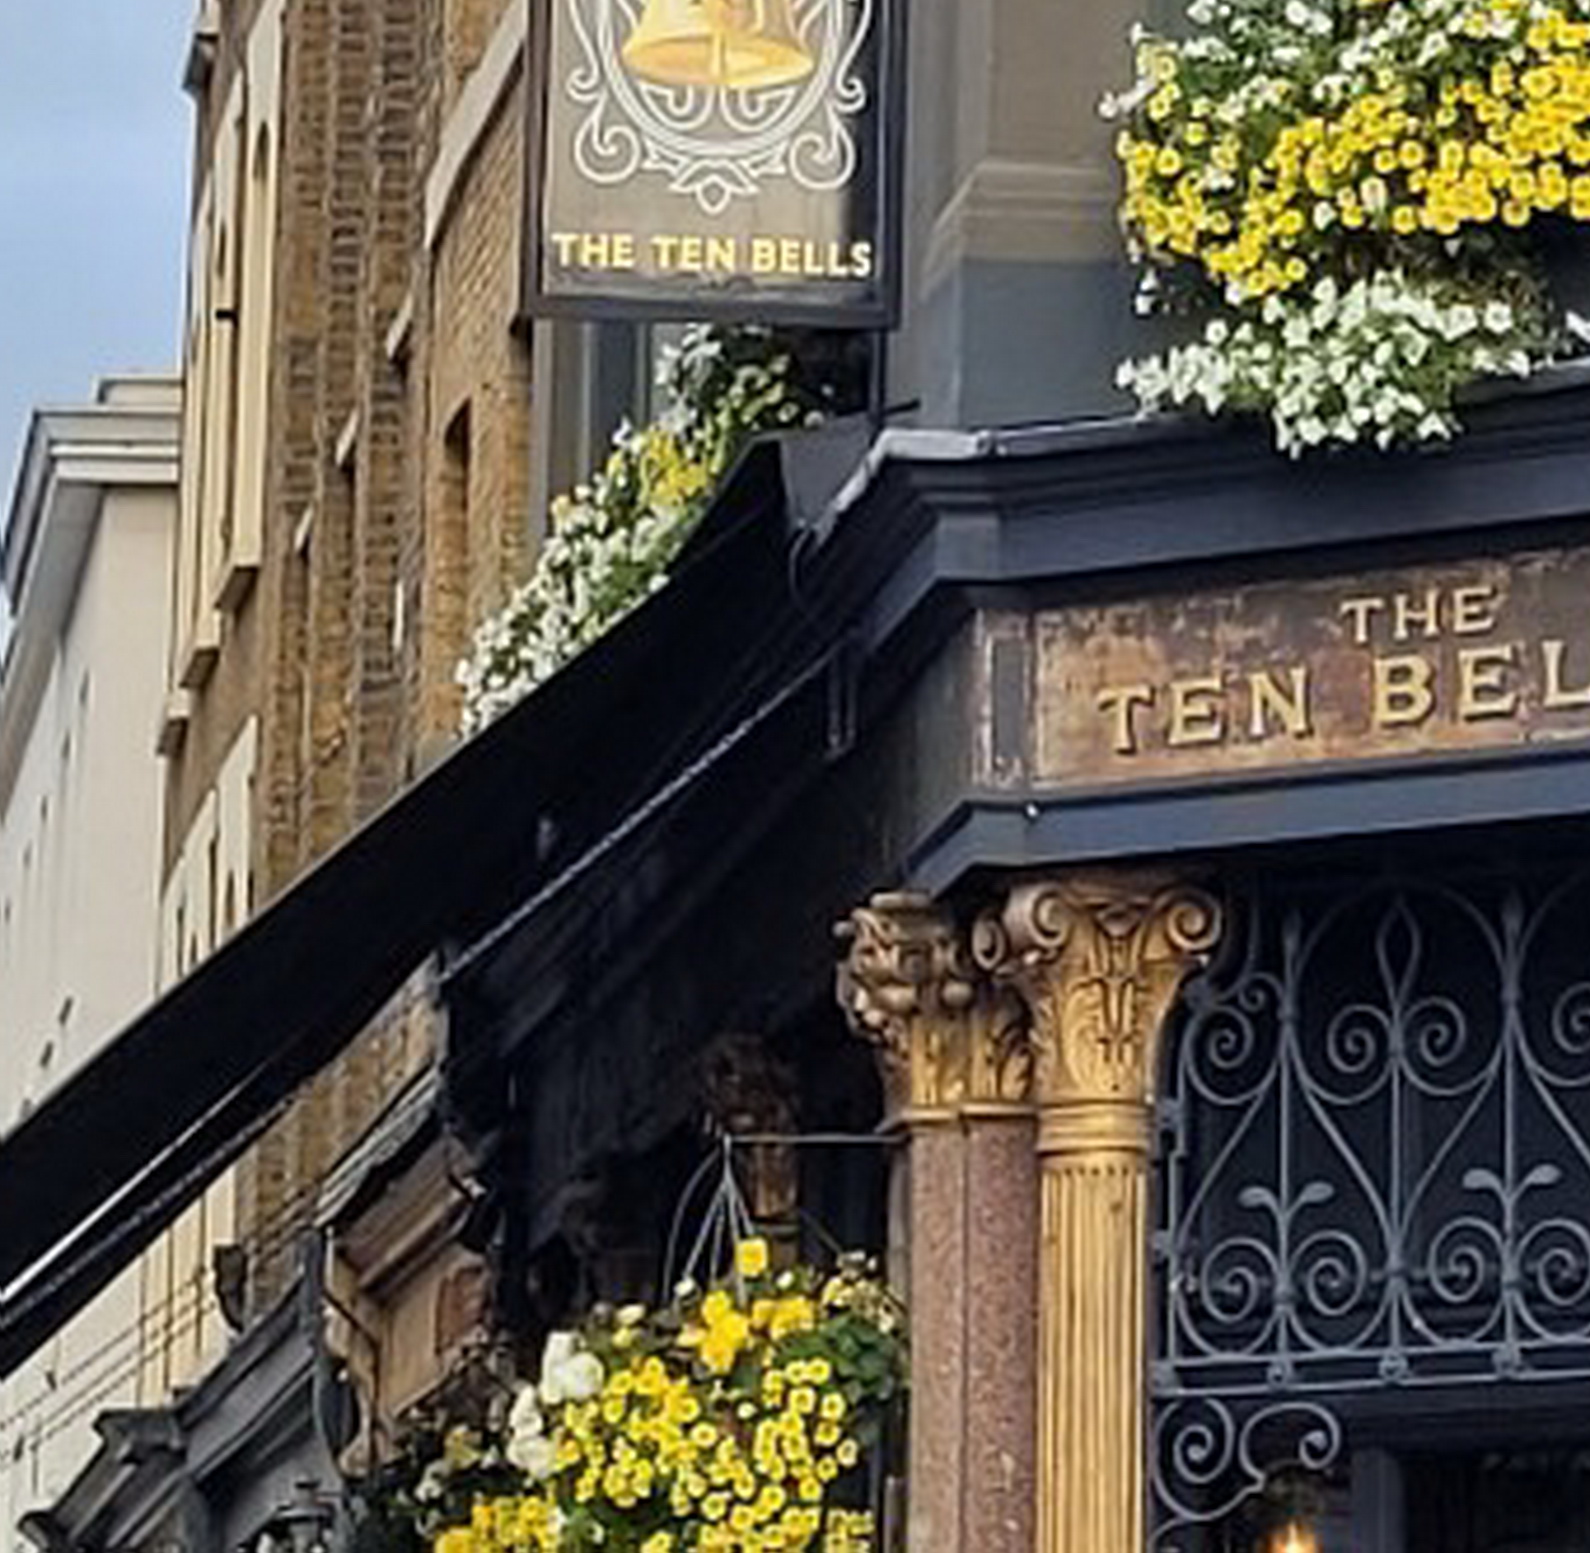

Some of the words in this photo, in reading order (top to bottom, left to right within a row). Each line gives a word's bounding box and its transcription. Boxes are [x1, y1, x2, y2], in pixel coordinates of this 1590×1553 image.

[553, 233, 634, 268] THE
[652, 235, 735, 273] TEN
[752, 238, 872, 277] BELLS
[1340, 583, 1502, 644] THE
[1097, 667, 1312, 753] TEN
